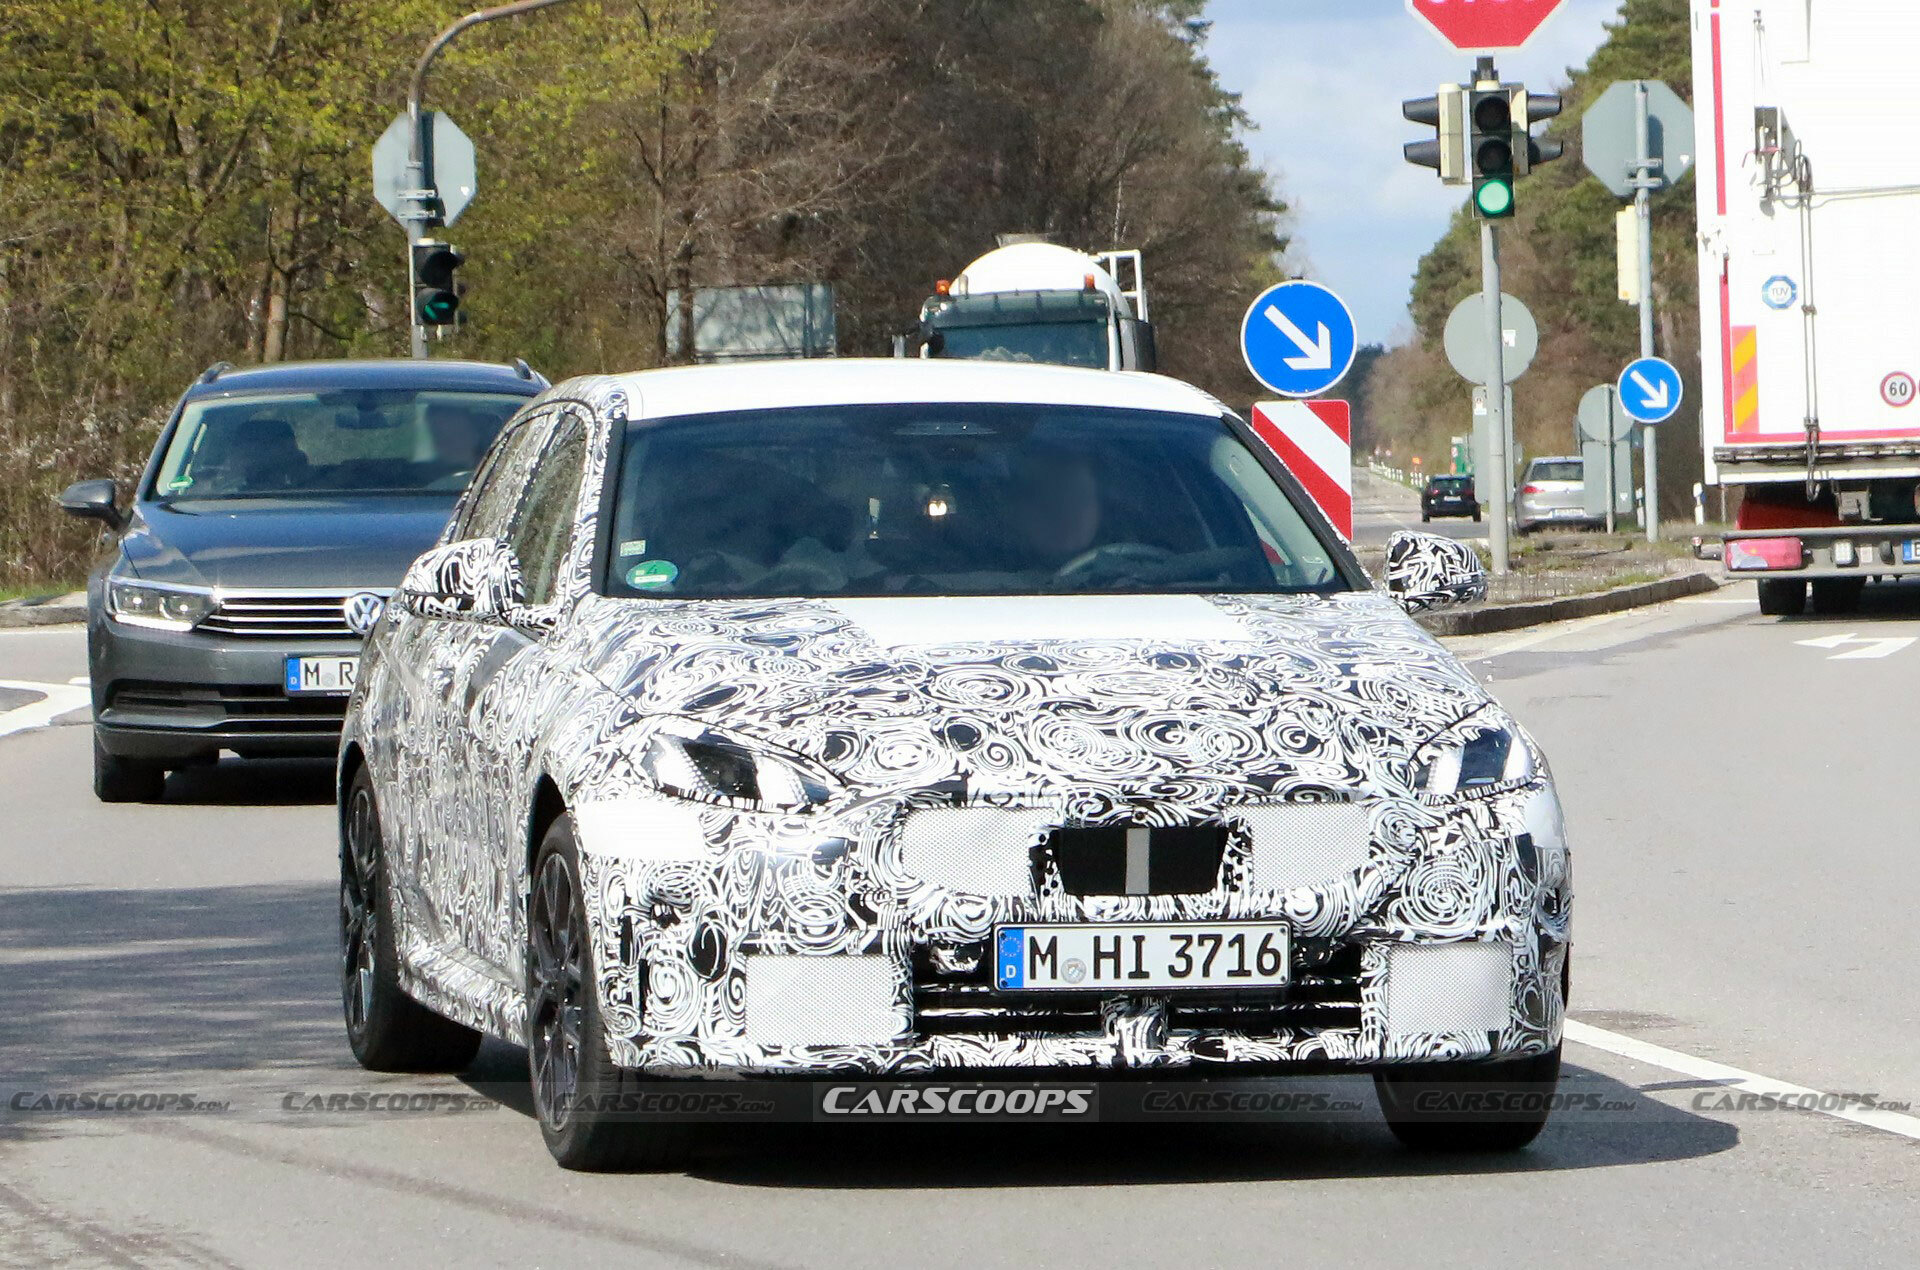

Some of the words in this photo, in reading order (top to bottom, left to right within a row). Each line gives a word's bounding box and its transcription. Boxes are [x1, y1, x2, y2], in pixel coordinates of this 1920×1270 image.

[1889, 381, 1907, 396] 60
[304, 662, 320, 685] M
[1029, 936, 1058, 980] M
[1093, 935, 1149, 979] HI
[1168, 933, 1282, 978] 3716
[1005, 965, 1016, 978] D
